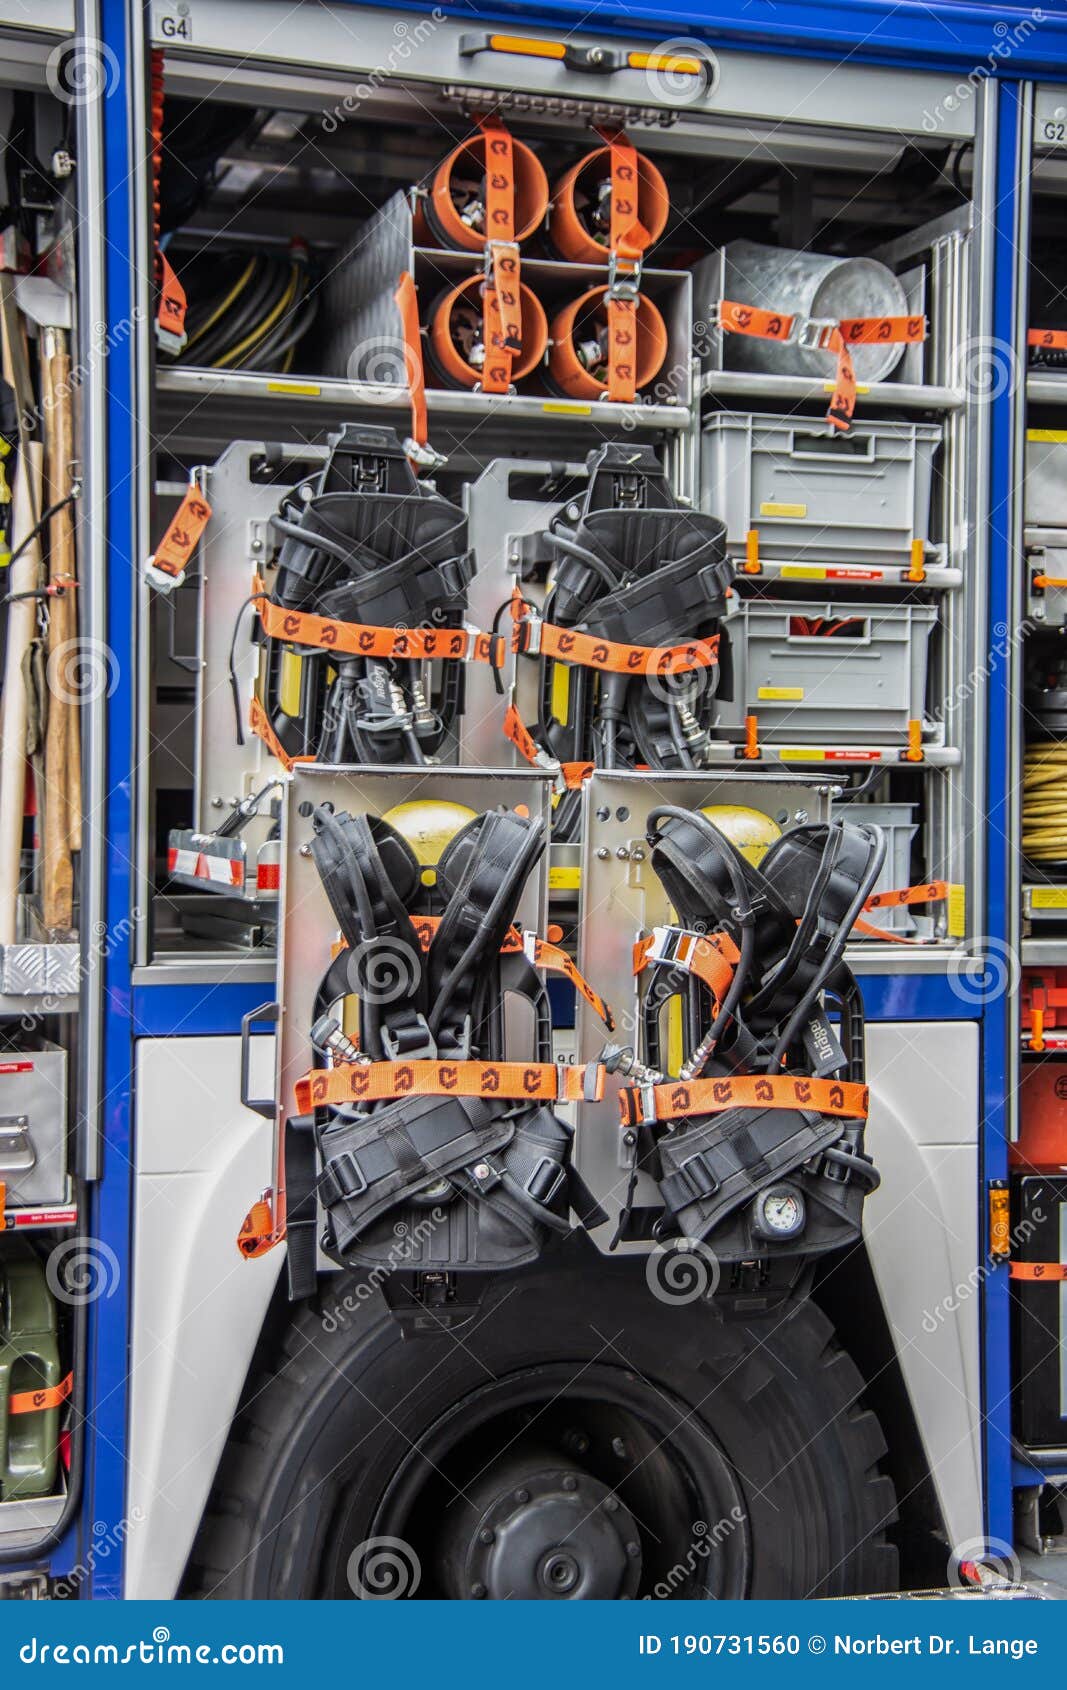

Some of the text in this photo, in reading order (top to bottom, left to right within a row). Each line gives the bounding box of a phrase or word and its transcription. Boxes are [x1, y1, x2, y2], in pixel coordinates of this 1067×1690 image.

[161, 16, 188, 39] G4
[1044, 122, 1065, 140] G2
[808, 1019, 834, 1061] Dräger
